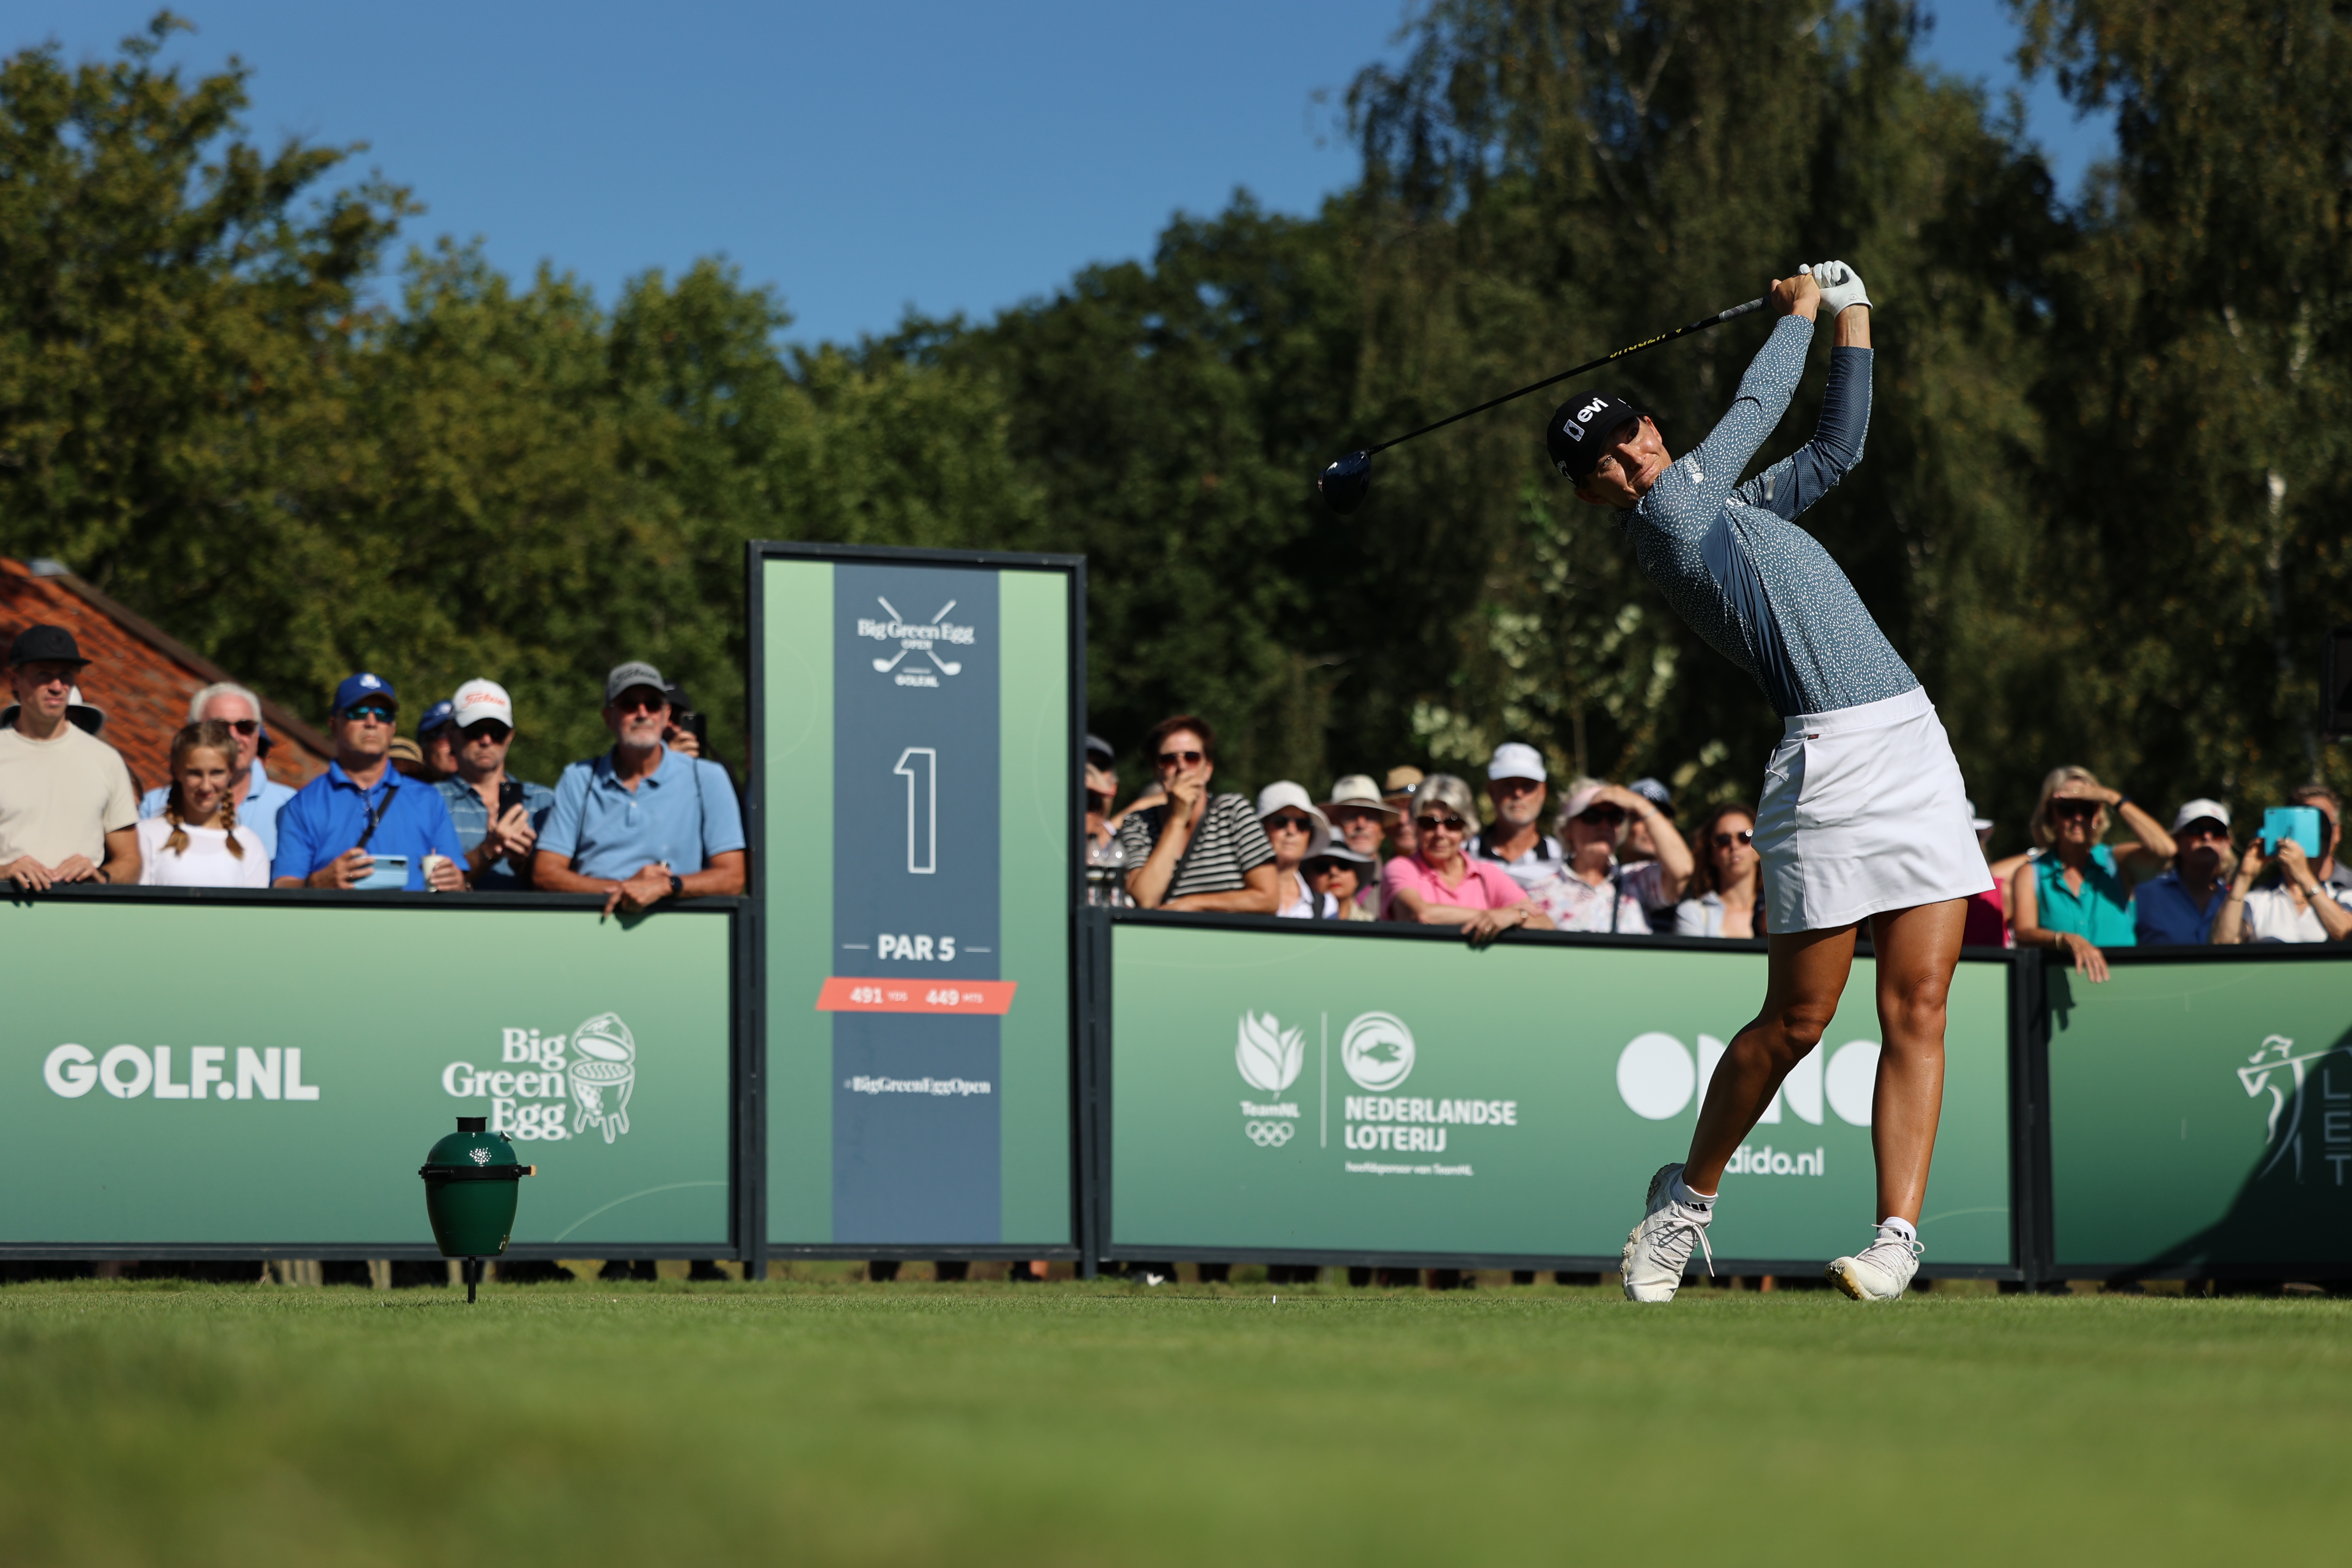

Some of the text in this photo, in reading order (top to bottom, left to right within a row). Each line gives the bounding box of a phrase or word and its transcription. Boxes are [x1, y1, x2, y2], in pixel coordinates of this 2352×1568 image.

[1577, 397, 1609, 423] evi
[857, 619, 975, 645] Big Green Egg
[893, 747, 937, 875] 1
[878, 934, 956, 962] PAR 5
[850, 986, 884, 1004] 491
[925, 989, 960, 1006] 449
[502, 1028, 567, 1071] Big
[43, 1043, 320, 1100] GOLF.NL
[442, 1061, 567, 1098] Green
[490, 1098, 567, 1141] Egg
[1240, 1100, 1300, 1118] TeamNL
[1345, 1096, 1518, 1126] NEDERLANDSE
[1344, 1125, 1447, 1152] LOTERIJ
[1413, 1164, 1432, 1175] van
[1724, 1145, 1825, 1176] dido.nl
